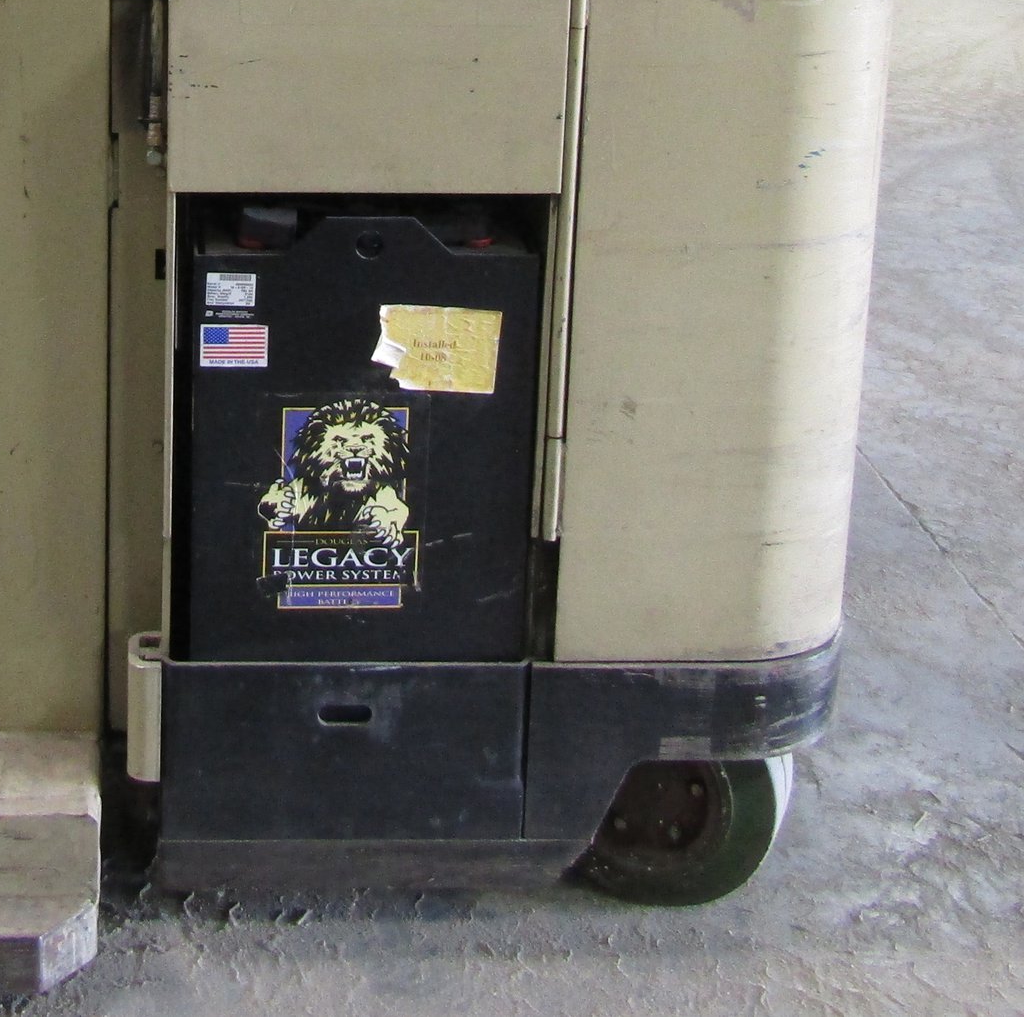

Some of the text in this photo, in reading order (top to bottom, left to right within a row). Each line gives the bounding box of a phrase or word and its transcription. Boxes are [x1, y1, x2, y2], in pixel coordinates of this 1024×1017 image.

[413, 339, 456, 349] Installed
[272, 547, 415, 568] LEGACY
[317, 589, 394, 598] PERFORMANCE
